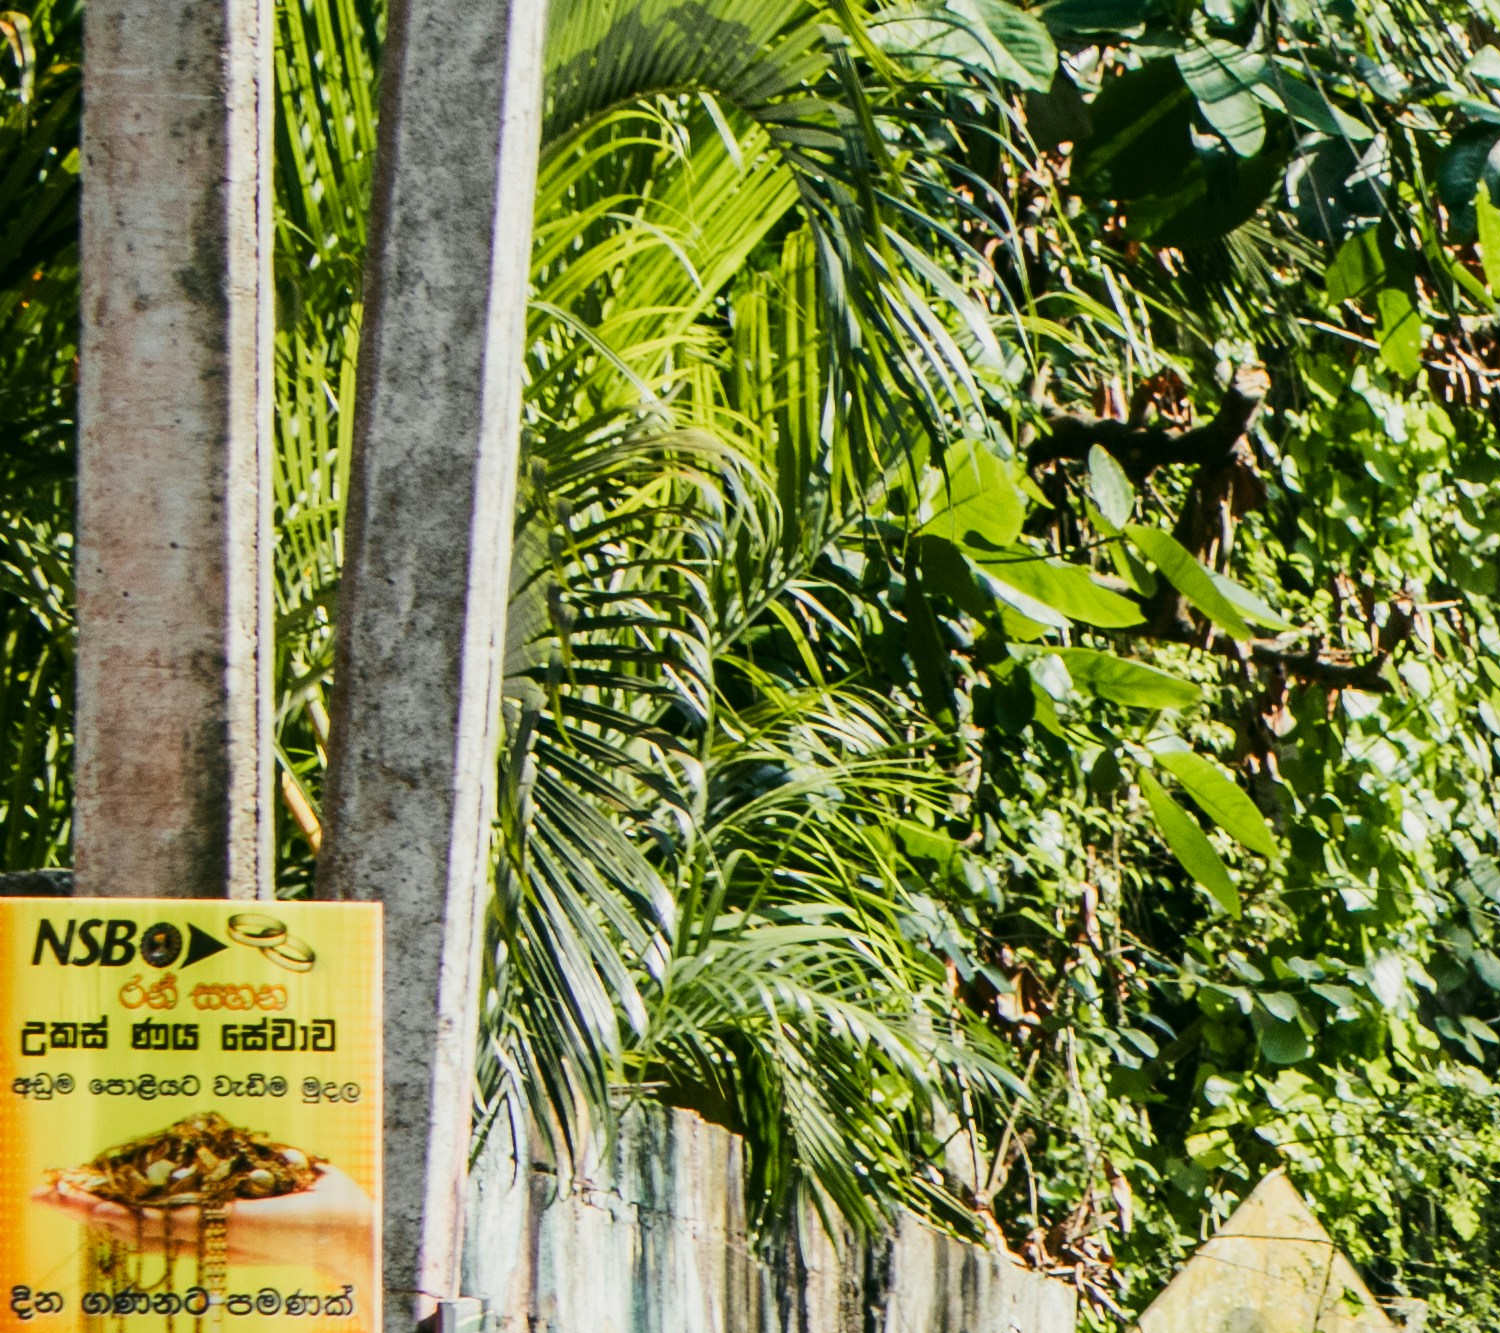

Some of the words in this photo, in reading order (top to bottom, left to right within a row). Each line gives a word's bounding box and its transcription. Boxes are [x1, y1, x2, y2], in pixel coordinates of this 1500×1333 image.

[32, 918, 138, 968] NSB
[191, 980, 288, 1011] සහන
[21, 1015, 108, 1056] උකස්
[131, 1017, 199, 1051] ණය
[222, 1017, 336, 1052] සේවාව
[11, 1073, 75, 1100] අඩුම
[302, 1076, 362, 1103] මුදල
[10, 1284, 64, 1320] දින
[81, 1286, 210, 1318] ගණනට
[226, 1284, 354, 1317] පමණක්
